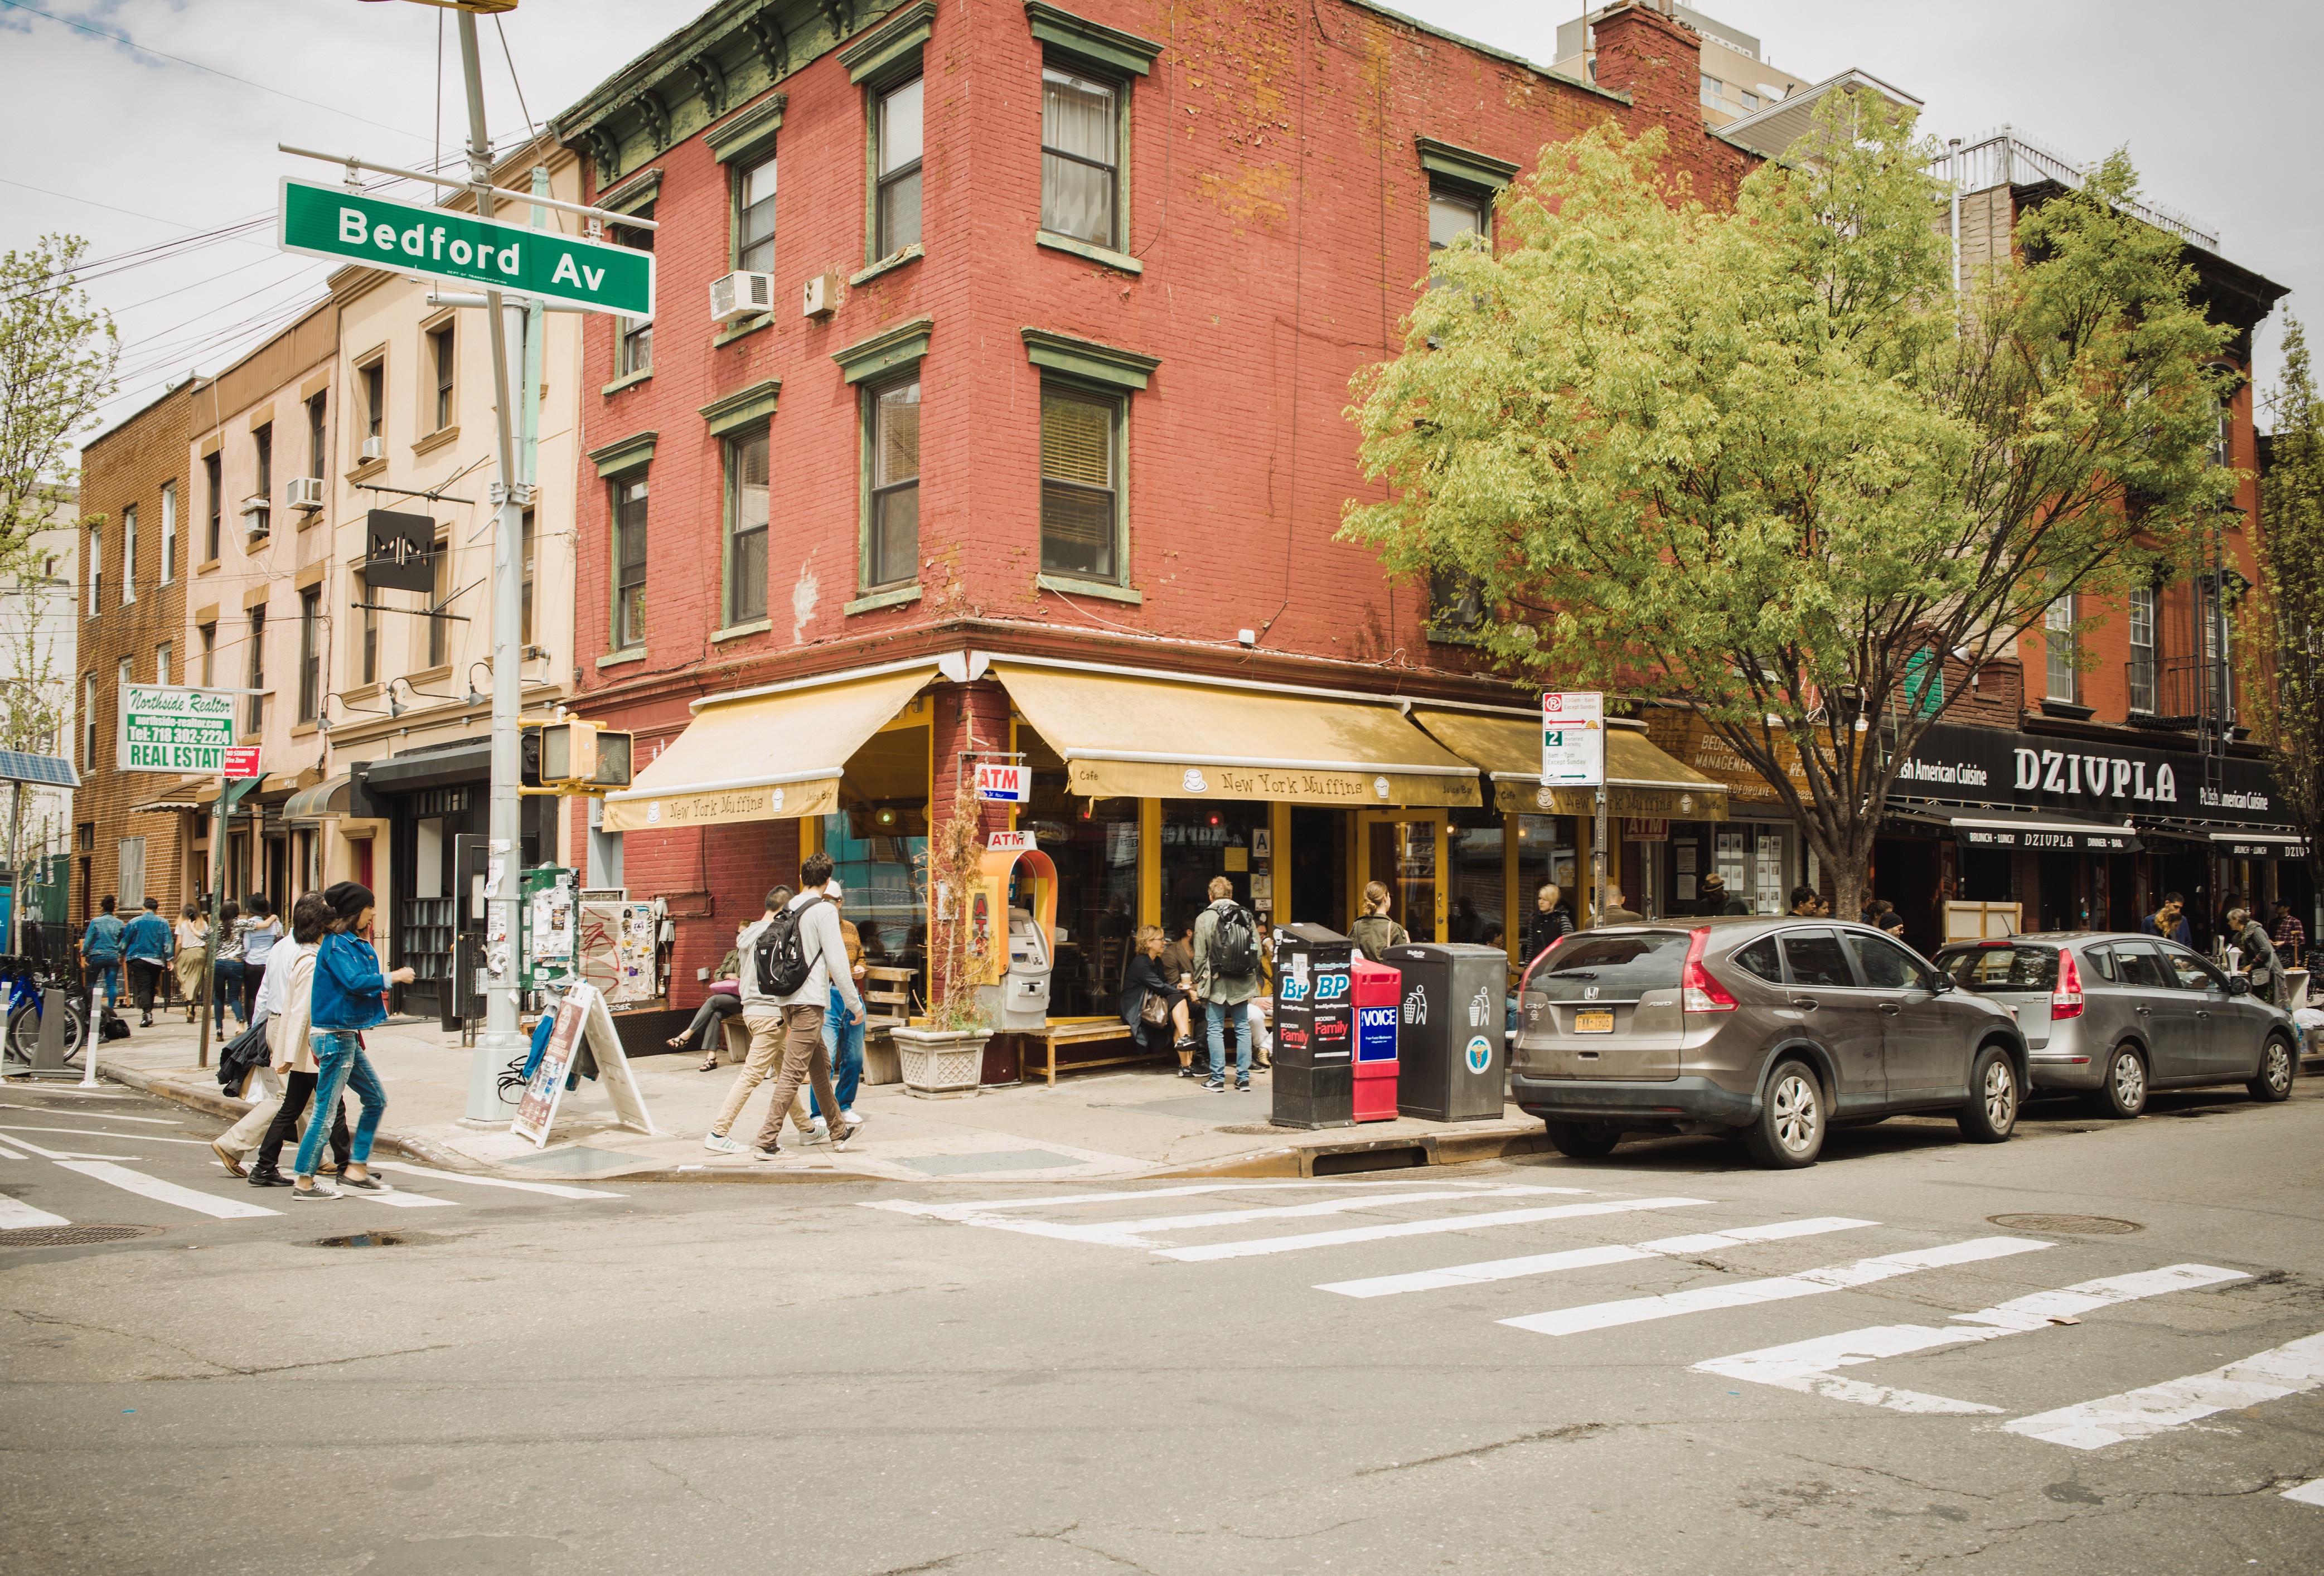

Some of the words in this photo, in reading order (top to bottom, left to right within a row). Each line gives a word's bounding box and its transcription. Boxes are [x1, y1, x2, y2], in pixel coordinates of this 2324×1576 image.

[338, 206, 520, 276] Bedford
[551, 253, 606, 291] Av
[468, 274, 507, 284] TRANSPORTATION
[130, 689, 185, 711] Northside
[189, 694, 231, 713] Realtor
[135, 716, 224, 729] northside-realtor.com
[129, 726, 151, 741] Tel:
[152, 727, 172, 742] 718
[174, 728, 230, 745] 302-2224
[1549, 731, 1558, 745] 2
[131, 745, 169, 767] REAL
[174, 746, 225, 768] ESTAT
[977, 769, 1018, 789] ATM
[1080, 770, 1098, 780] Cafe
[1915, 759, 1955, 783] American
[1957, 763, 1987, 786] Cuisine
[1221, 773, 1253, 792] New
[1258, 774, 1298, 794] York
[1302, 776, 1362, 796] Muffins
[1442, 784, 1460, 794] Juice
[1461, 785, 1473, 794] Bar
[1727, 783, 1757, 796] EDFORD
[1757, 786, 1770, 796] AVE
[806, 792, 819, 802] Juice
[1500, 791, 1516, 799] Cafe
[1566, 792, 1590, 808] New
[1626, 794, 1672, 812] Muffins
[2219, 790, 2246, 808] merican
[2247, 792, 2268, 810] Cuisine
[670, 802, 690, 819] New
[693, 798, 718, 818] York
[720, 796, 764, 814] Muffins
[1628, 818, 1663, 833] ATM
[992, 834, 1024, 846] ATM
[1256, 833, 1267, 850] A
[1969, 833, 1992, 842] BRUNCH
[1997, 834, 2015, 843] LUNCH
[2088, 837, 2107, 847] DINNER
[2112, 838, 2123, 847] BAR
[975, 898, 987, 954] ATM
[1315, 976, 1348, 998] BP
[1363, 1010, 1396, 1026] VOICE
[1315, 1020, 1348, 1036] Family
[1280, 1028, 1309, 1046] Family
